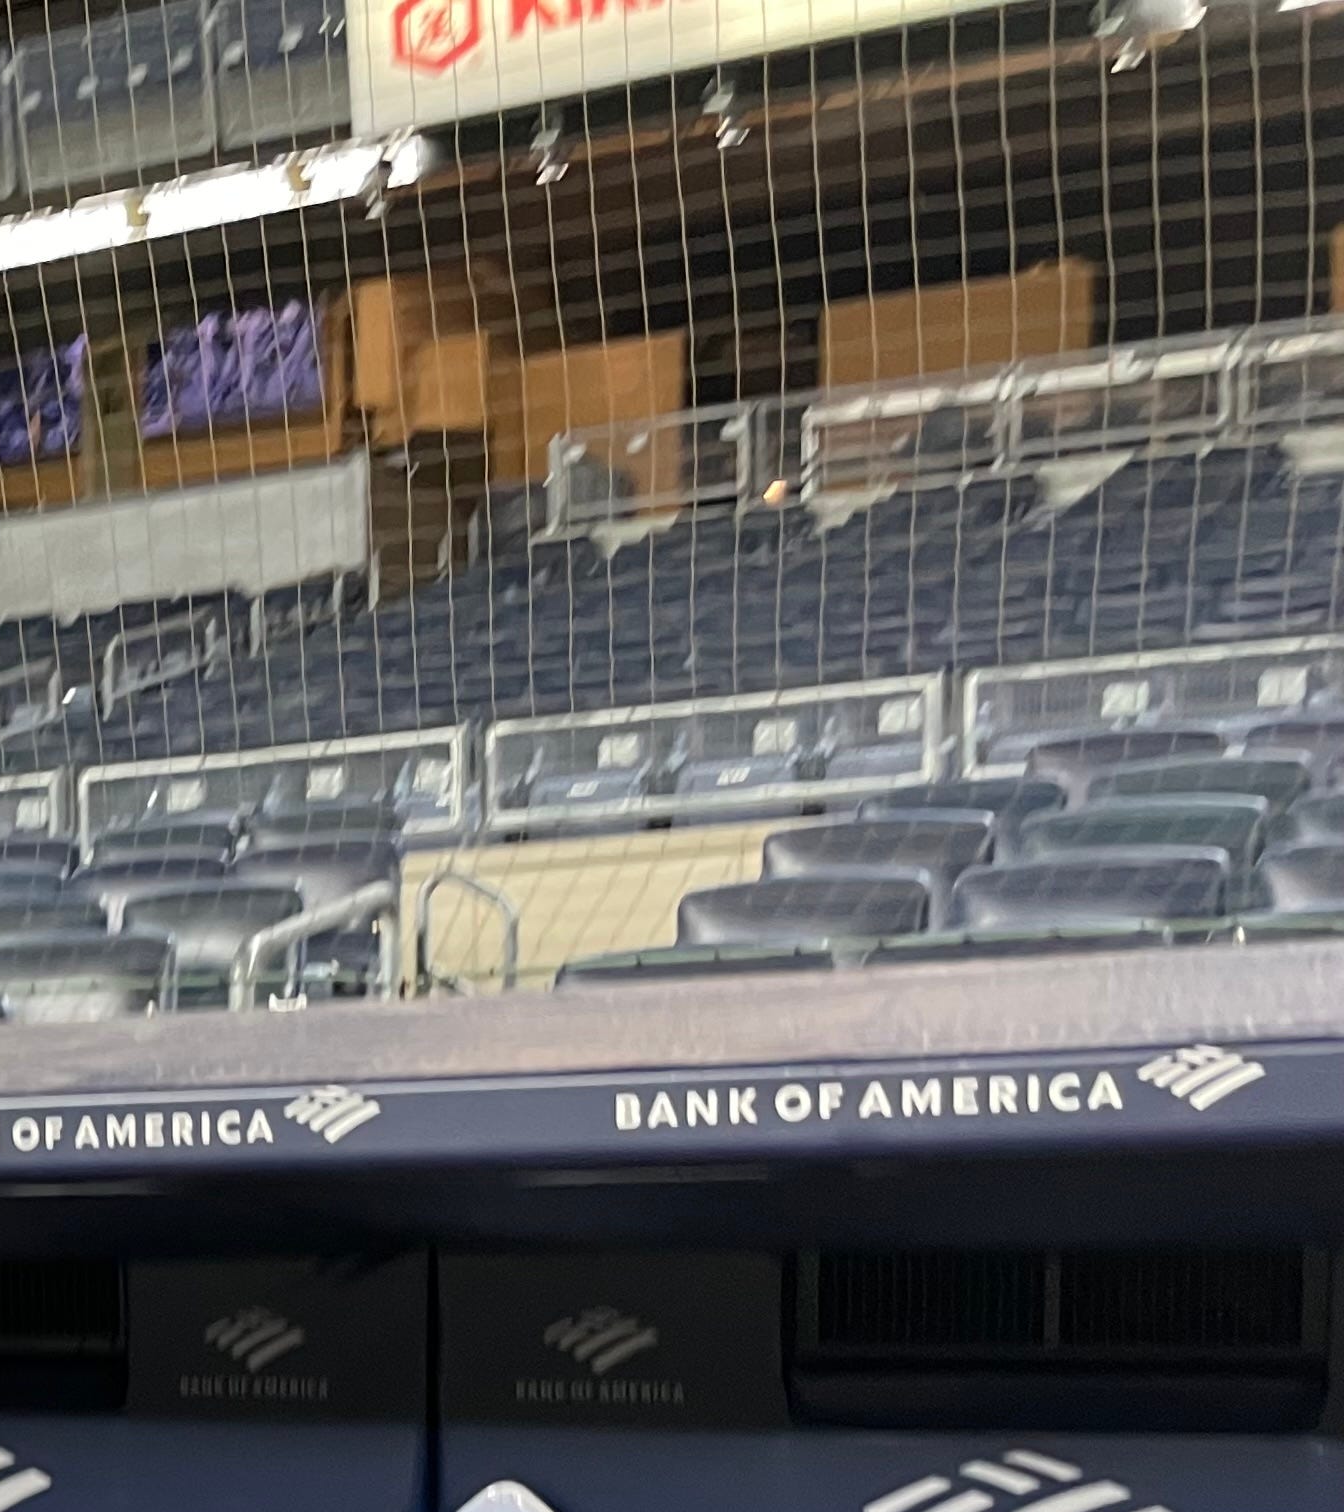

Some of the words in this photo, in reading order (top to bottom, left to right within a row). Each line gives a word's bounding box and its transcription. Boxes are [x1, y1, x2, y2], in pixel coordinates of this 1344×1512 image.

[614, 1087, 758, 1130] BANK
[775, 1082, 843, 1123] OF
[859, 1071, 1123, 1120] AMERICA
[12, 1116, 63, 1152] OF
[75, 1108, 274, 1150] AMERICA
